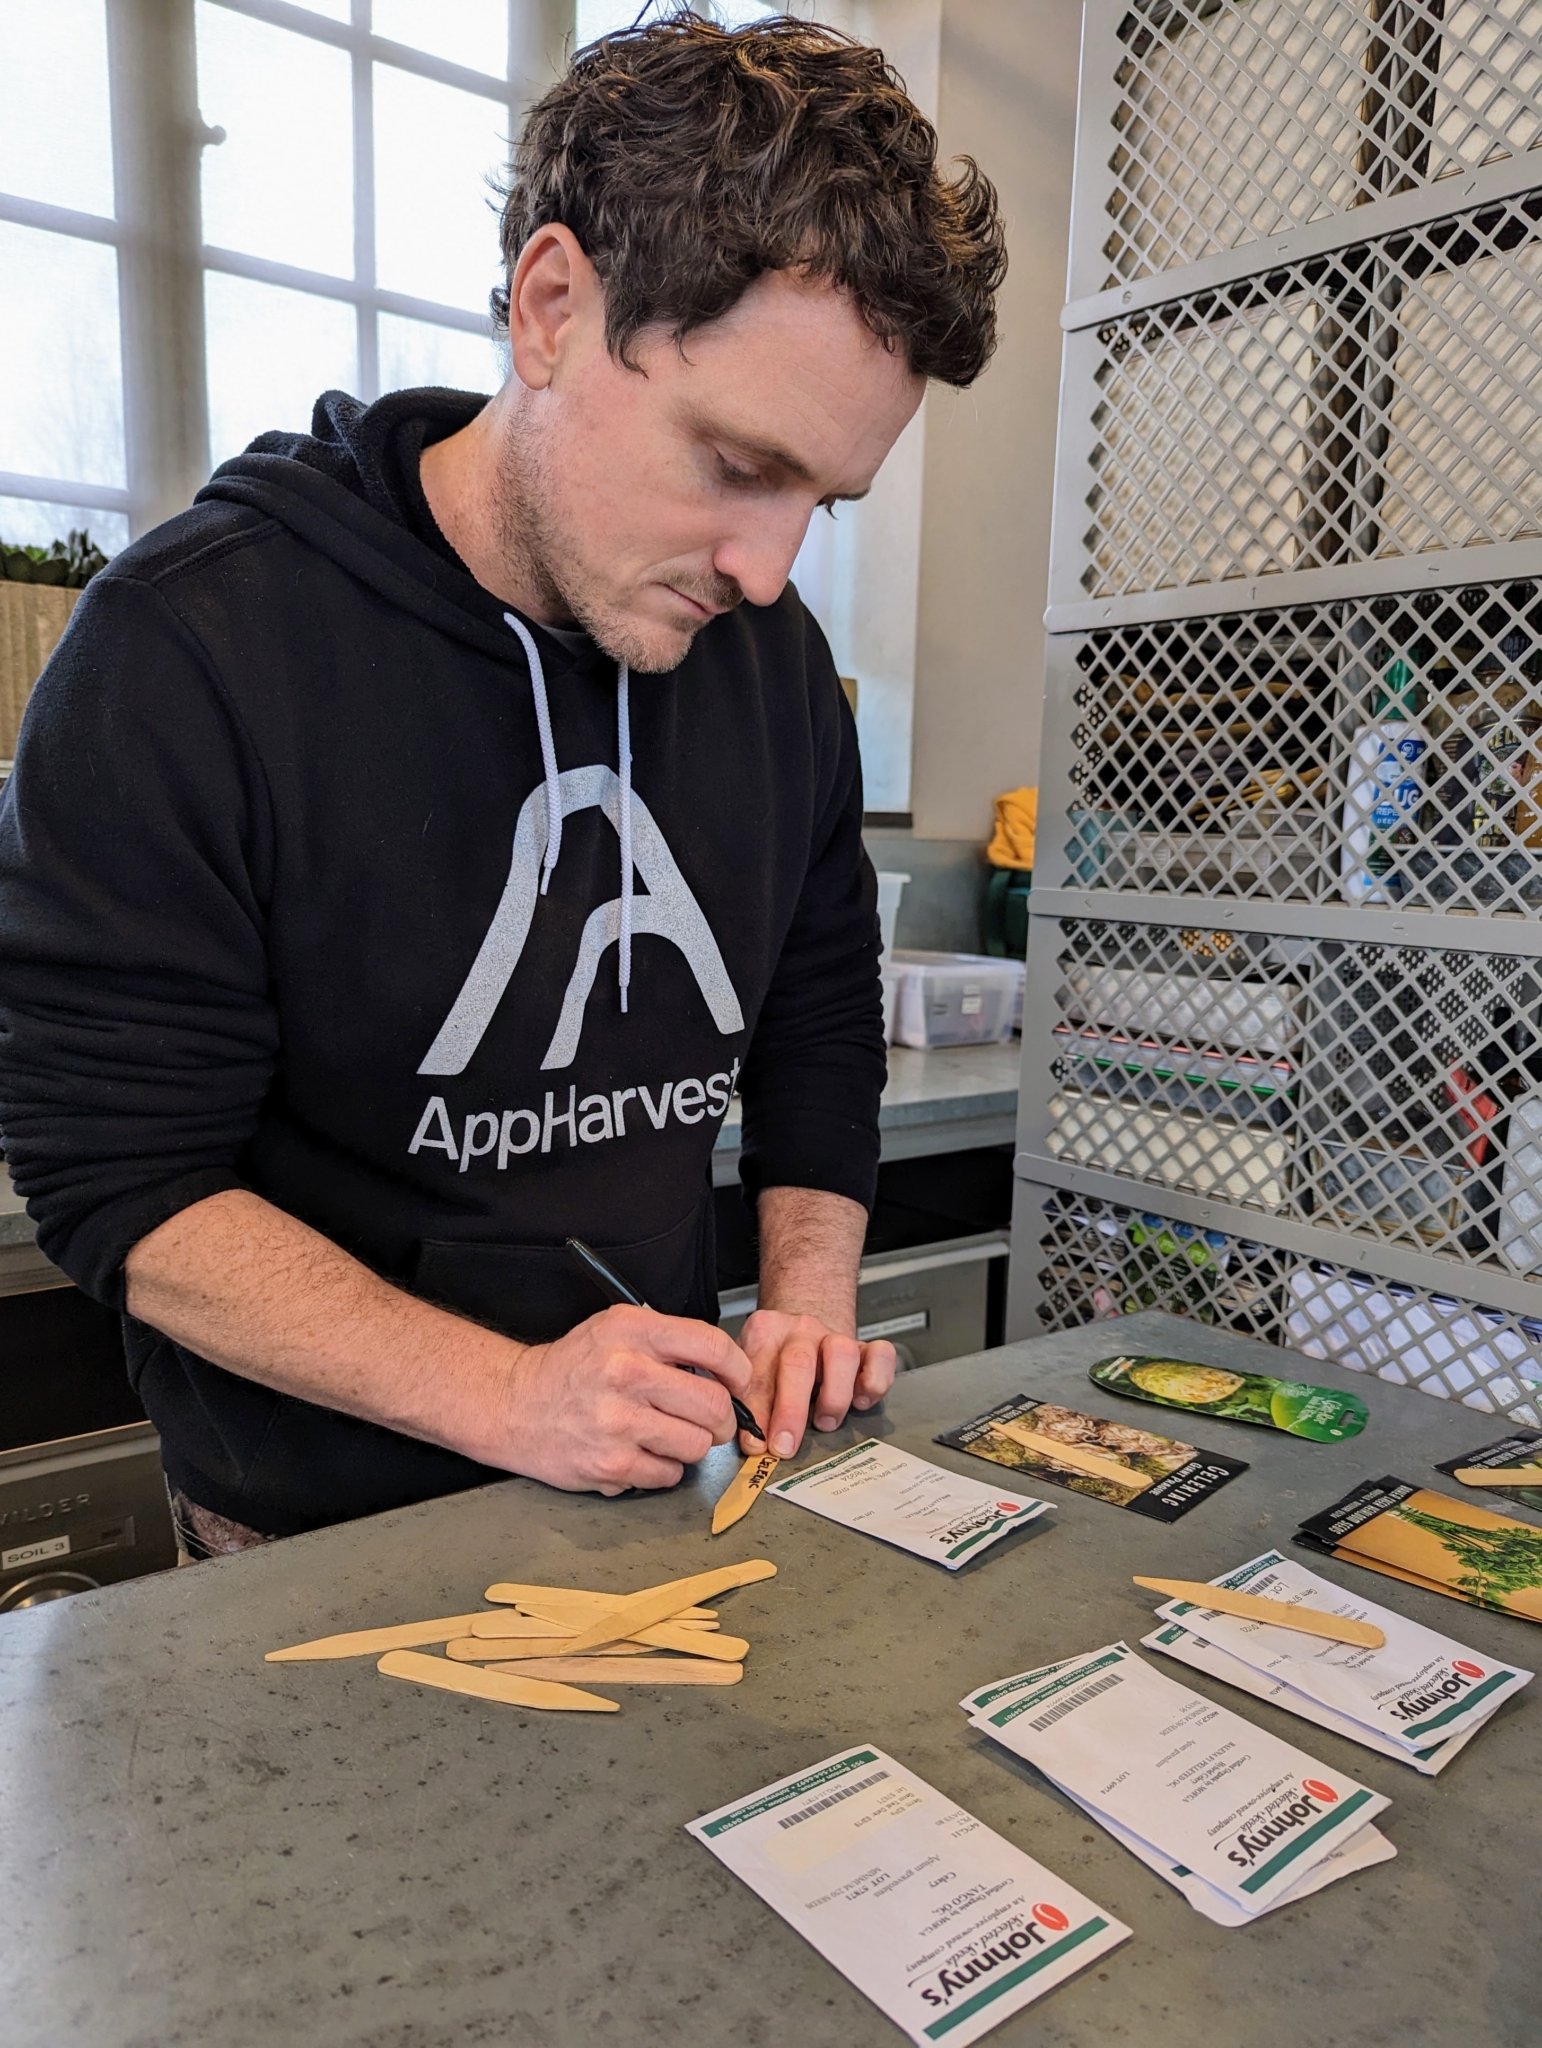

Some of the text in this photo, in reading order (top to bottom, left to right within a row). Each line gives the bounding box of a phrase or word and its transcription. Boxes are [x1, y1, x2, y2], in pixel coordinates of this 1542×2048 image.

[1148, 1462, 1202, 1495] GIANT PRAGUE
[1161, 1465, 1228, 1506] CELERIAC
[8, 1542, 65, 1563] SOIL 3
[1390, 1672, 1469, 1720] Johnny's
[1282, 1771, 1294, 1781] An
[742, 1806, 766, 1819] Maine
[1206, 1813, 1236, 1836] company
[1239, 1787, 1298, 1833] Selected Seeds
[1228, 1795, 1320, 1866] Johnny's
[913, 1854, 940, 1871] Apium
[845, 1872, 890, 1900] LOT 57871
[928, 1871, 956, 1887] Celery
[951, 1883, 986, 1905] TANGO
[905, 1894, 1025, 1972] An employee-owned company
[945, 1913, 1024, 1967] Selected Seeds
[921, 1921, 1046, 2006] Johnny's
